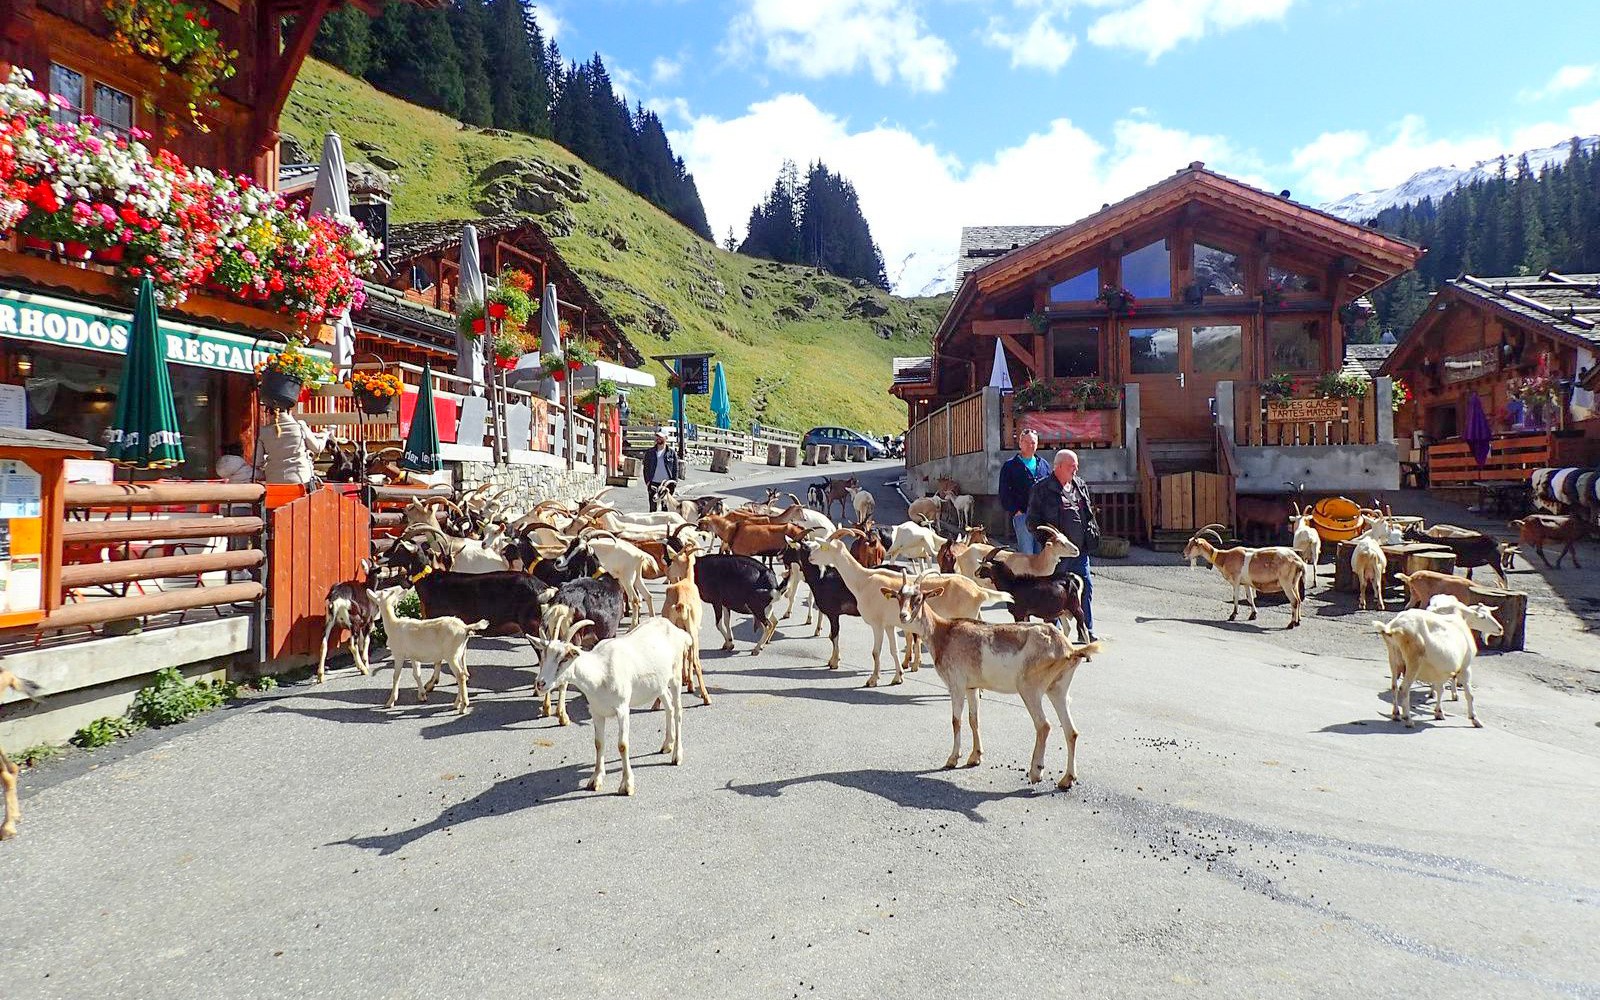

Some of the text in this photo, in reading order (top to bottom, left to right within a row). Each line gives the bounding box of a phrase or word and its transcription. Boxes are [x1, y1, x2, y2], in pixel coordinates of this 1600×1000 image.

[165, 334, 270, 371] RESTAU
[1272, 408, 1338, 418] TARTES MAISON
